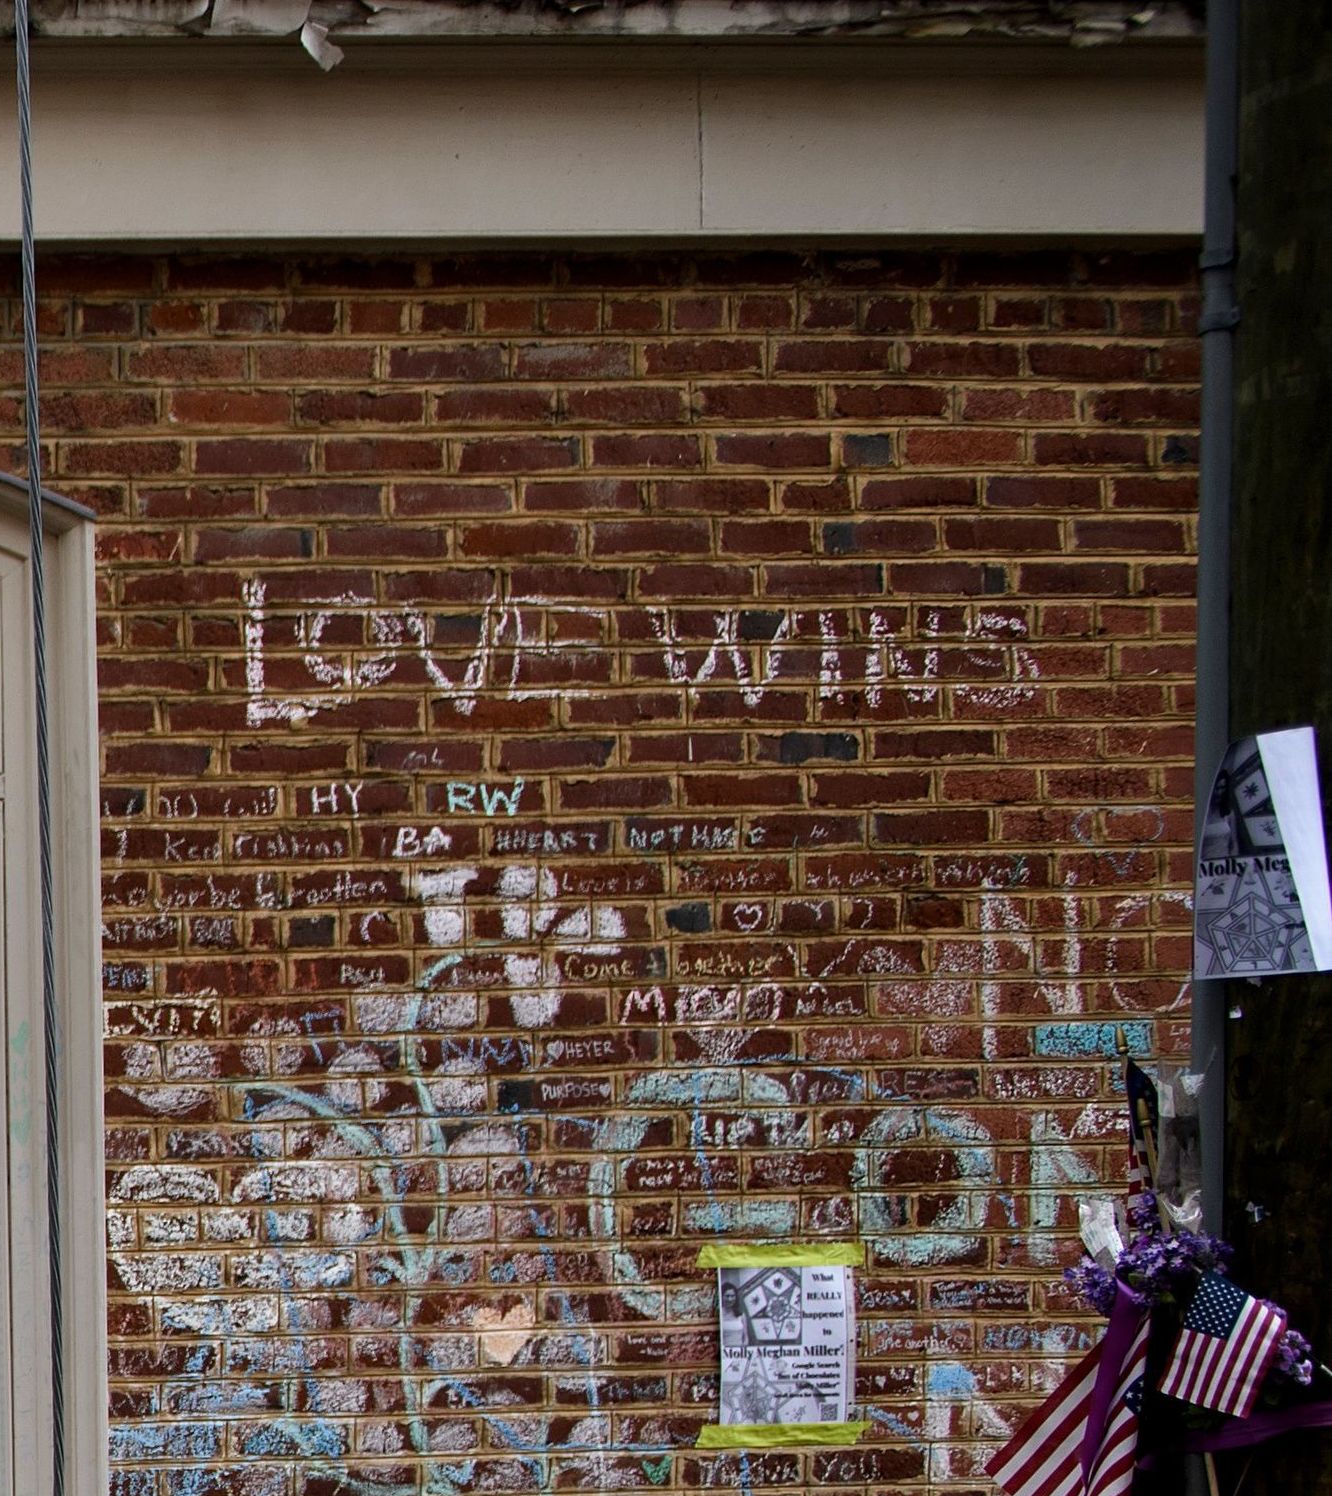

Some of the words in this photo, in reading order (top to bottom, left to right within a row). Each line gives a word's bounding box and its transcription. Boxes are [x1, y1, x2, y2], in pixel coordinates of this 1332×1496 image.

[243, 577, 608, 727] LOVE
[446, 776, 526, 817] RW
[1198, 857, 1248, 878] Molly
[565, 1038, 616, 1059] HEYER
[541, 1081, 601, 1101] PURPOSE
[812, 1273, 834, 1282] What
[806, 1292, 842, 1301] REALLY
[723, 1346, 753, 1360] Molly
[757, 1346, 801, 1359] Meghan
